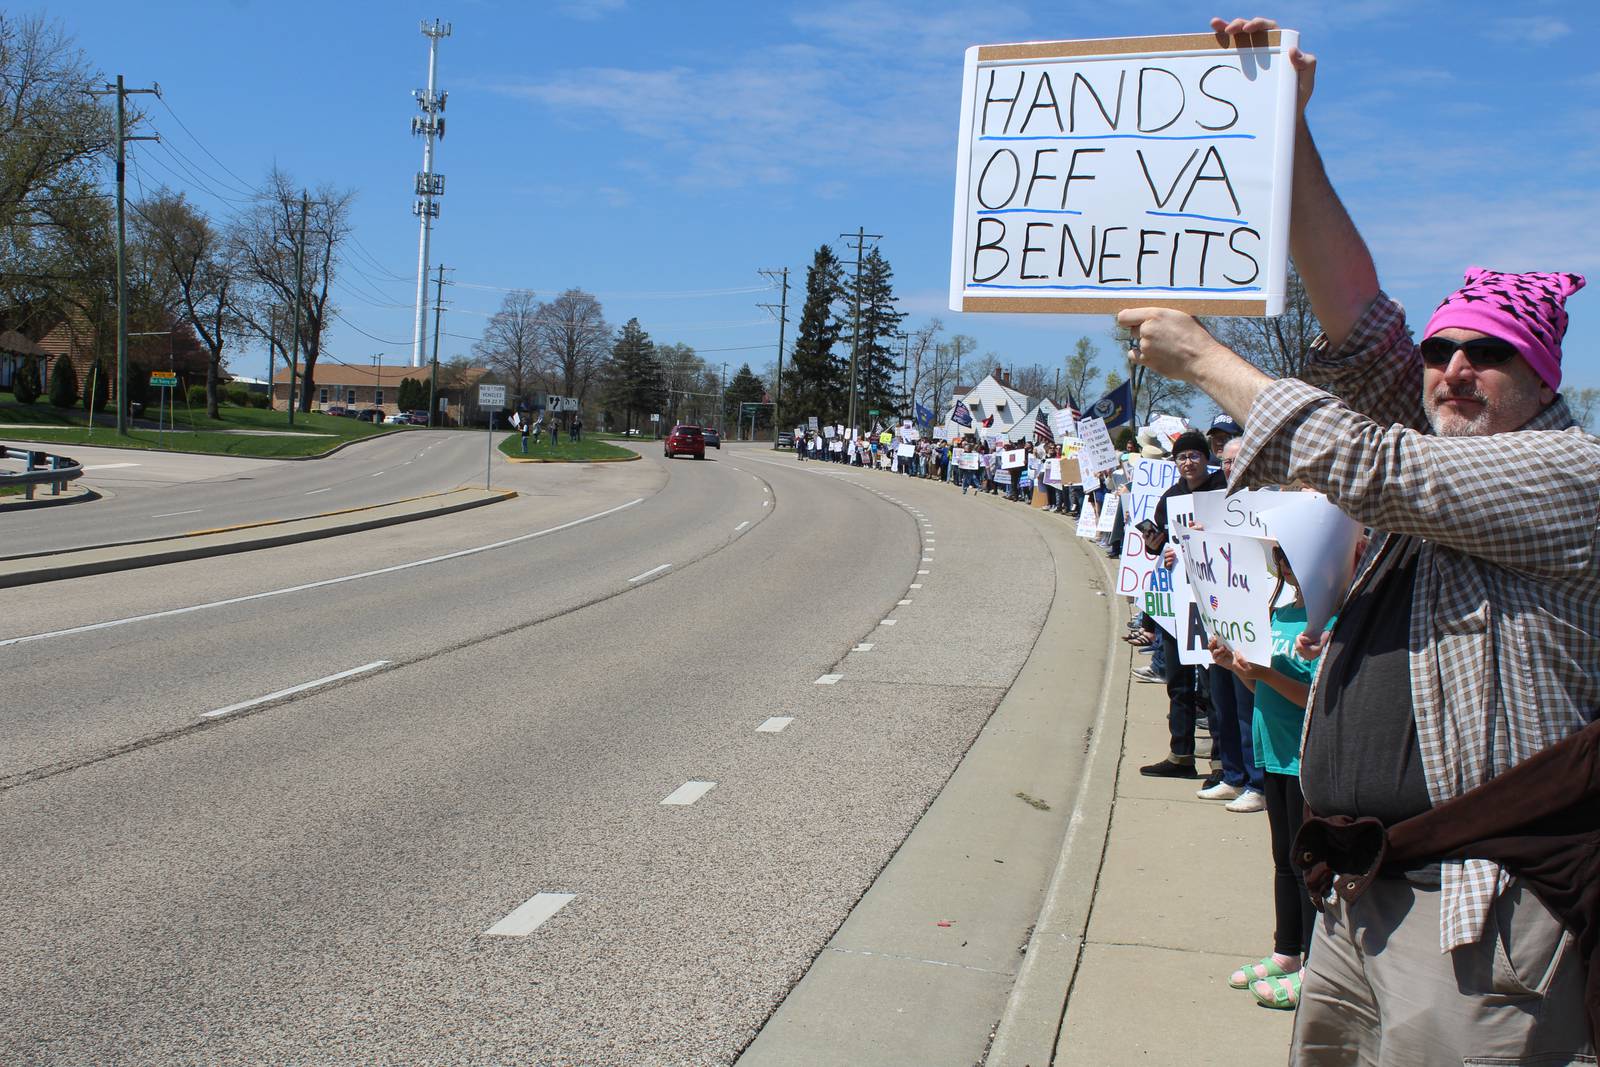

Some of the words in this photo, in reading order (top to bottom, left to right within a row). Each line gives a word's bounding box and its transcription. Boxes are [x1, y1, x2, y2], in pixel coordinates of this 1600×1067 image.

[981, 65, 1242, 135] HANDS
[977, 148, 1106, 210] OFF
[1136, 145, 1241, 215] VA
[972, 217, 1261, 287] BENEFITS
[1219, 542, 1251, 593] You
